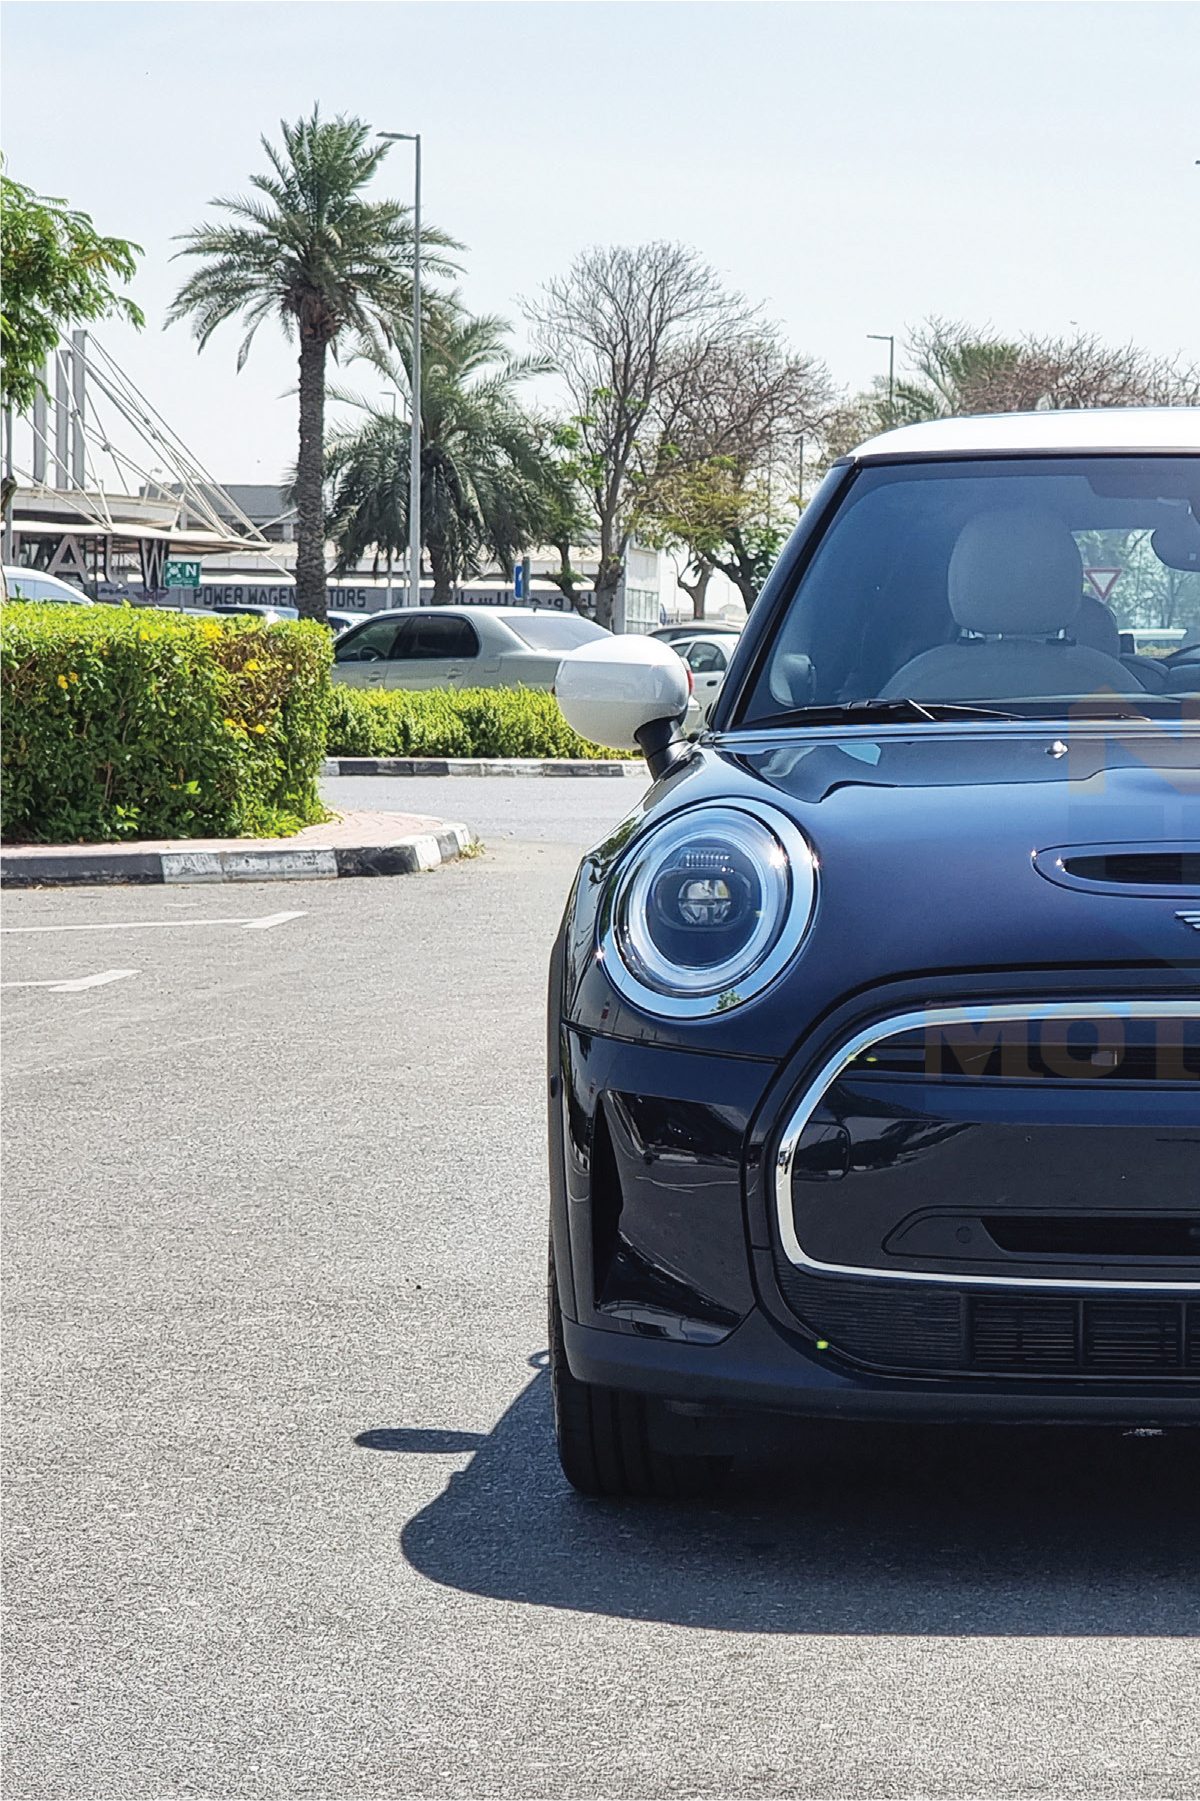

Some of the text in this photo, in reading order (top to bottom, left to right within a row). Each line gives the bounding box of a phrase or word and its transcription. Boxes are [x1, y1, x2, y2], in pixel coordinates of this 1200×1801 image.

[185, 563, 198, 578] N
[192, 586, 367, 608] POWER WAGEN TORS
